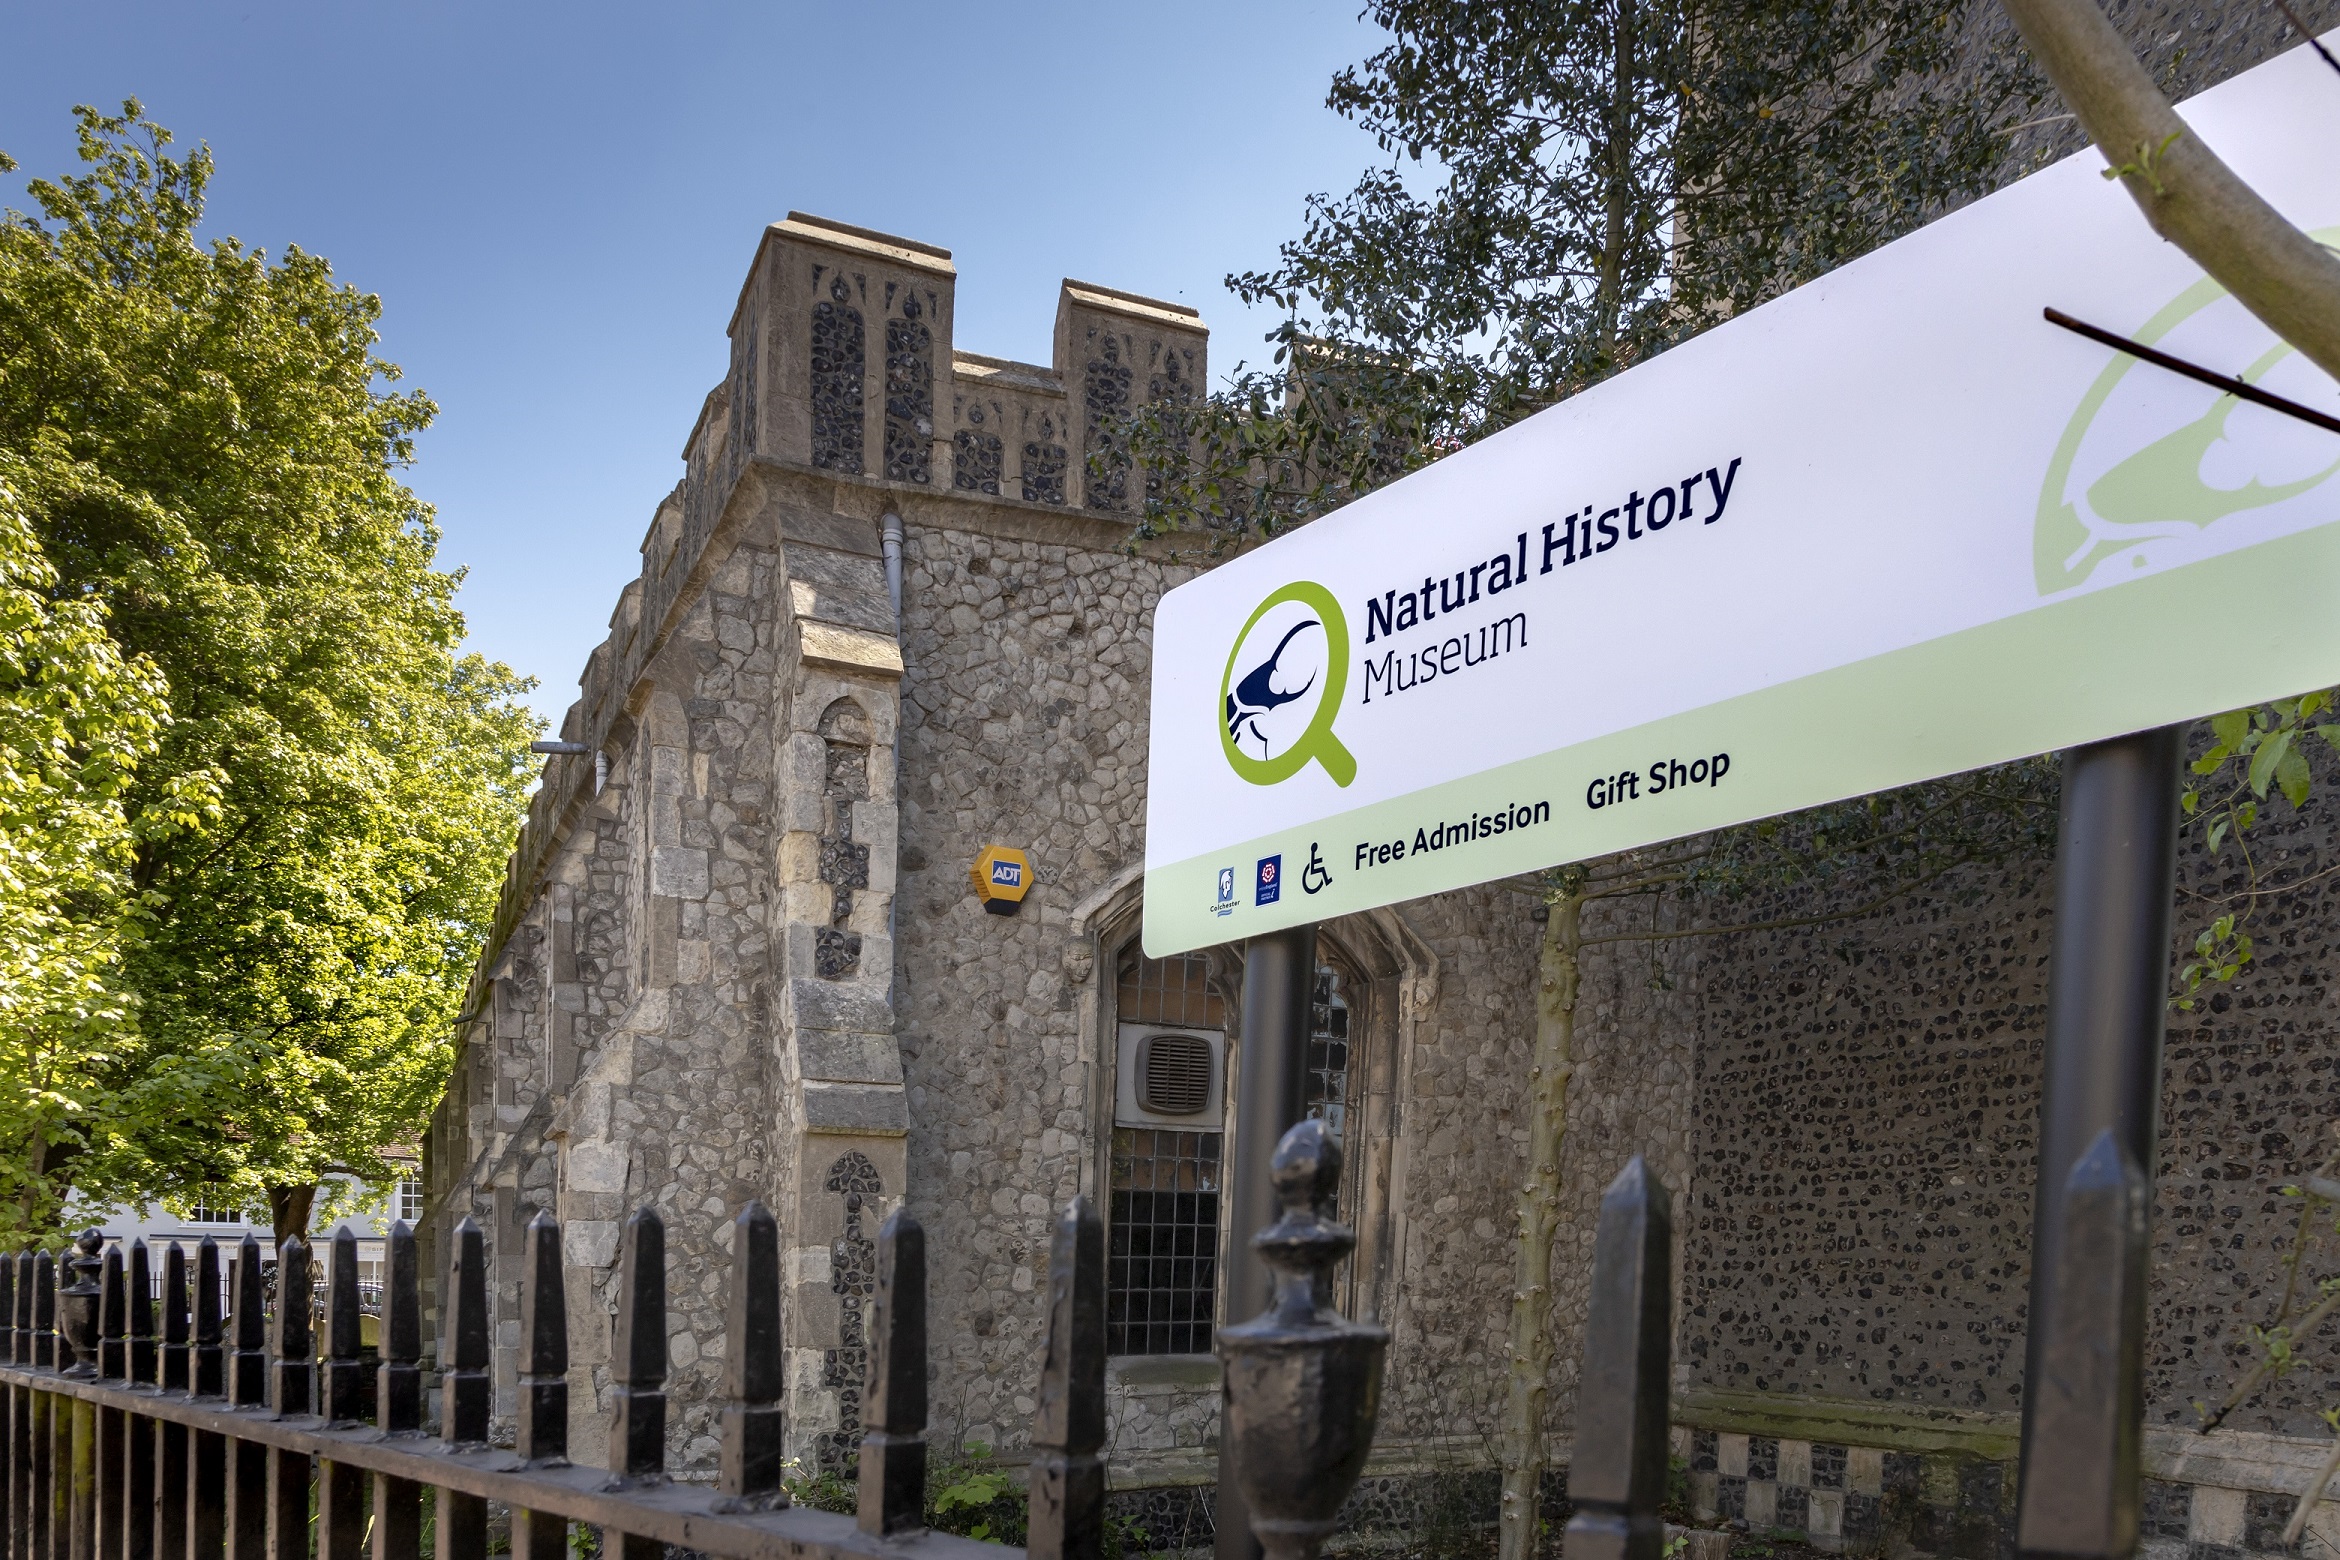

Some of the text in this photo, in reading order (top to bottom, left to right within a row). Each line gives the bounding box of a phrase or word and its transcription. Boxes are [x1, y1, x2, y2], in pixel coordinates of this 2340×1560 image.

[1366, 457, 1742, 644] Natural History
[1363, 612, 1528, 705] Museum
[1586, 752, 1731, 810] Gift Shop
[1355, 800, 1550, 871] Free Admission
[992, 866, 1021, 882] ADT
[1209, 900, 1241, 912] Colchester
